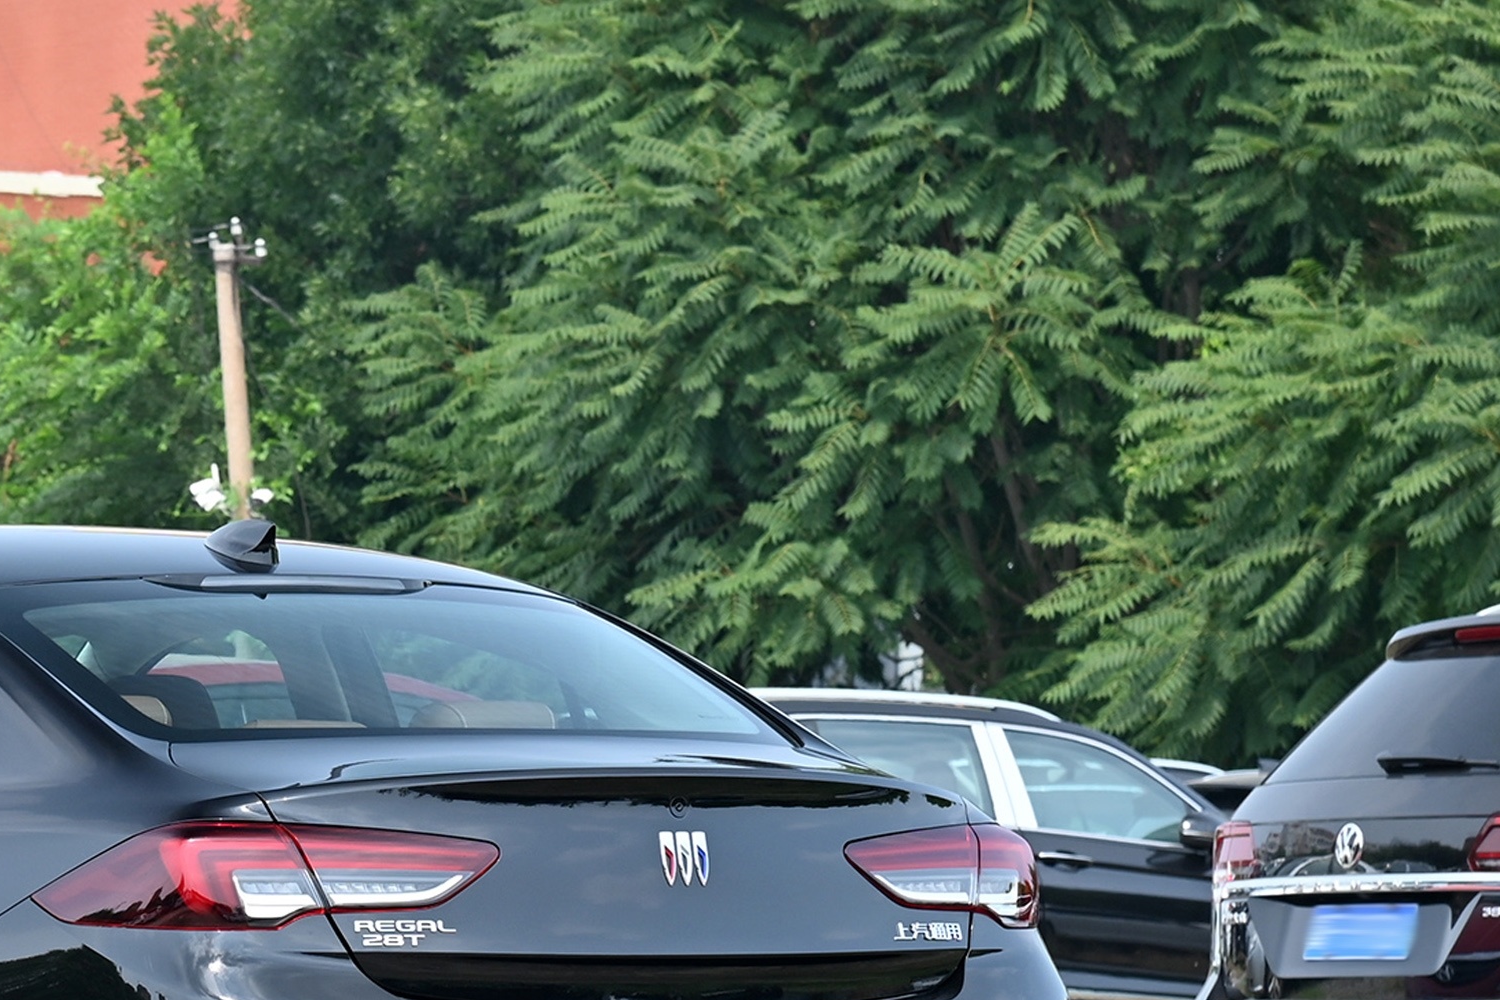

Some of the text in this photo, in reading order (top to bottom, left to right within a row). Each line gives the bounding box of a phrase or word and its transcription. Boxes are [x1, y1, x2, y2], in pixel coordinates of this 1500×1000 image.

[354, 919, 457, 933] REGAL
[893, 921, 963, 941] 上汽通用
[362, 934, 426, 947] 28T
